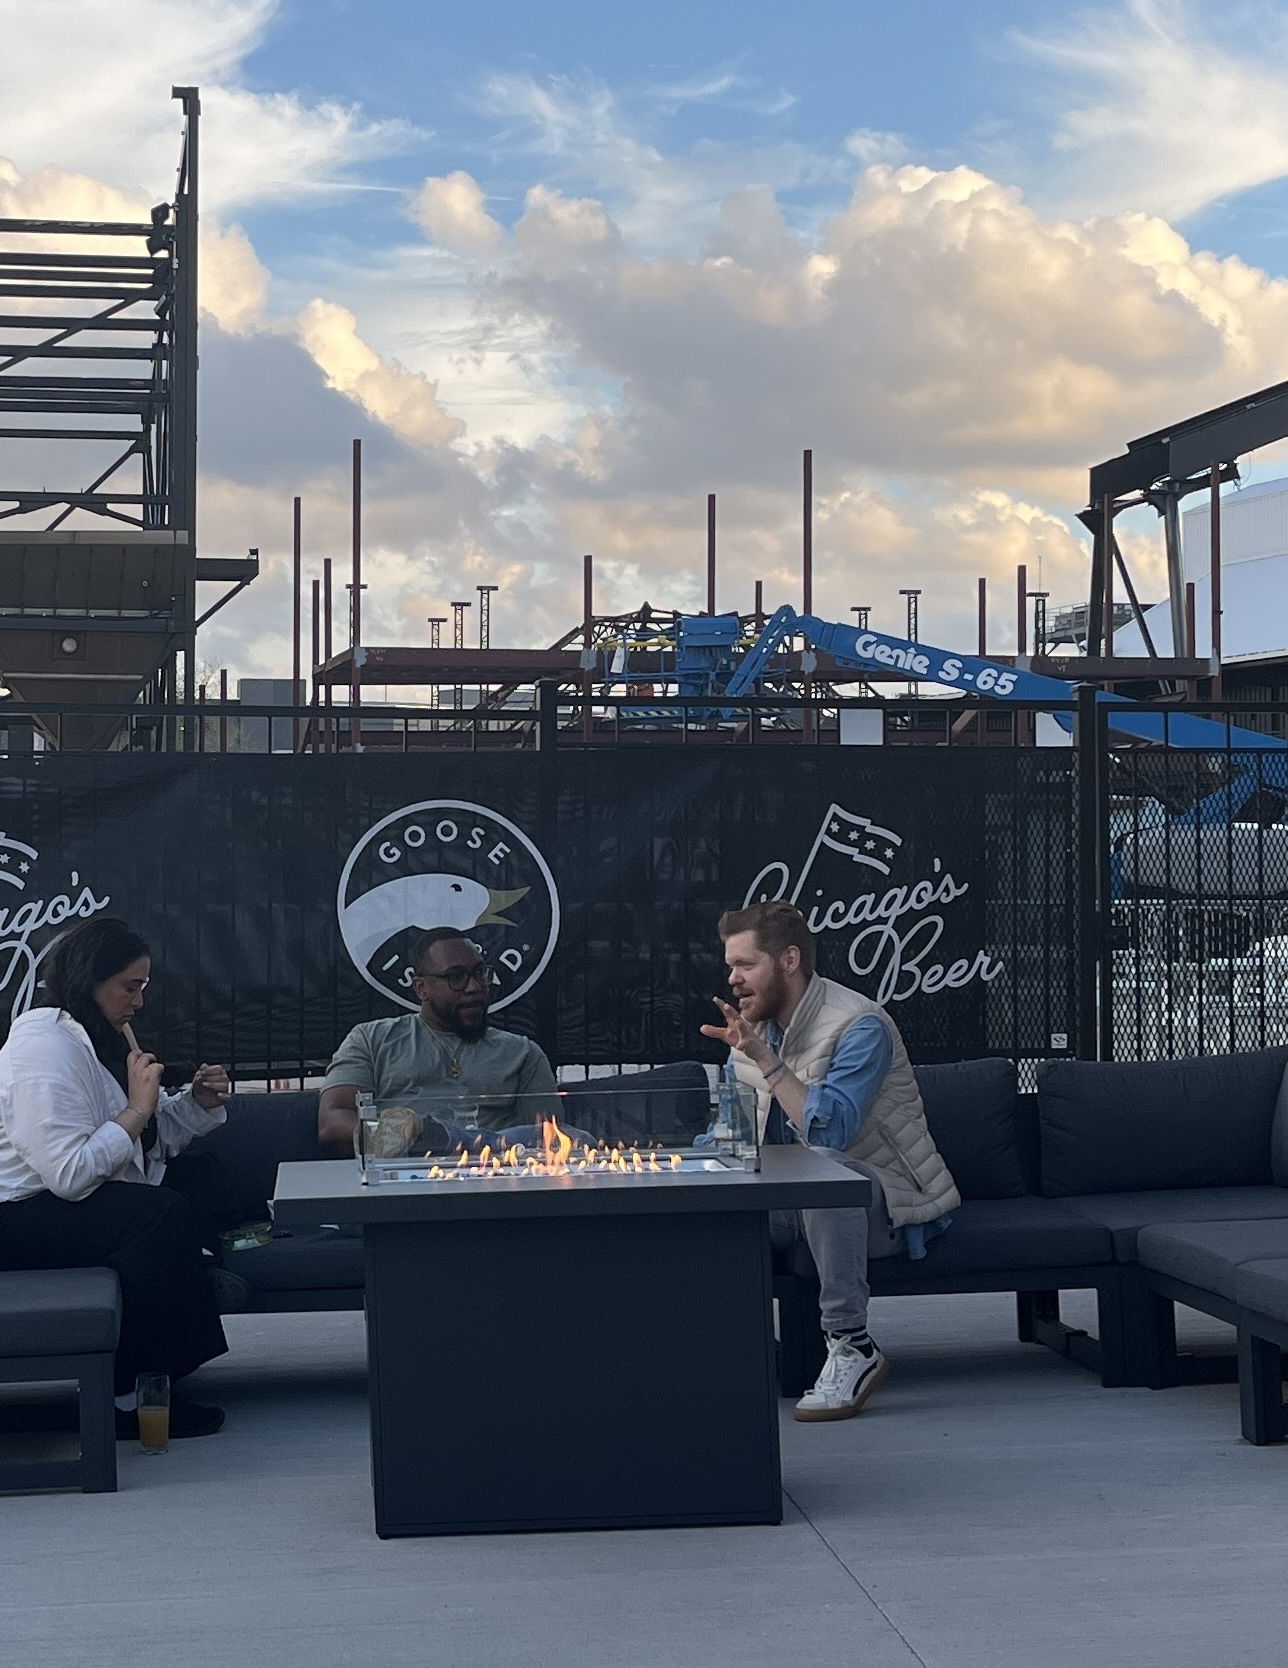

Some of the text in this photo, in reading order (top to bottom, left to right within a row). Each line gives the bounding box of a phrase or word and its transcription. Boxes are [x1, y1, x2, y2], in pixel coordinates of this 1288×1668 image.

[855, 633, 1018, 695] Genie S-65
[378, 819, 511, 865] GOOSE
[742, 834, 969, 933] Cicago's
[848, 915, 1004, 1005] Beer
